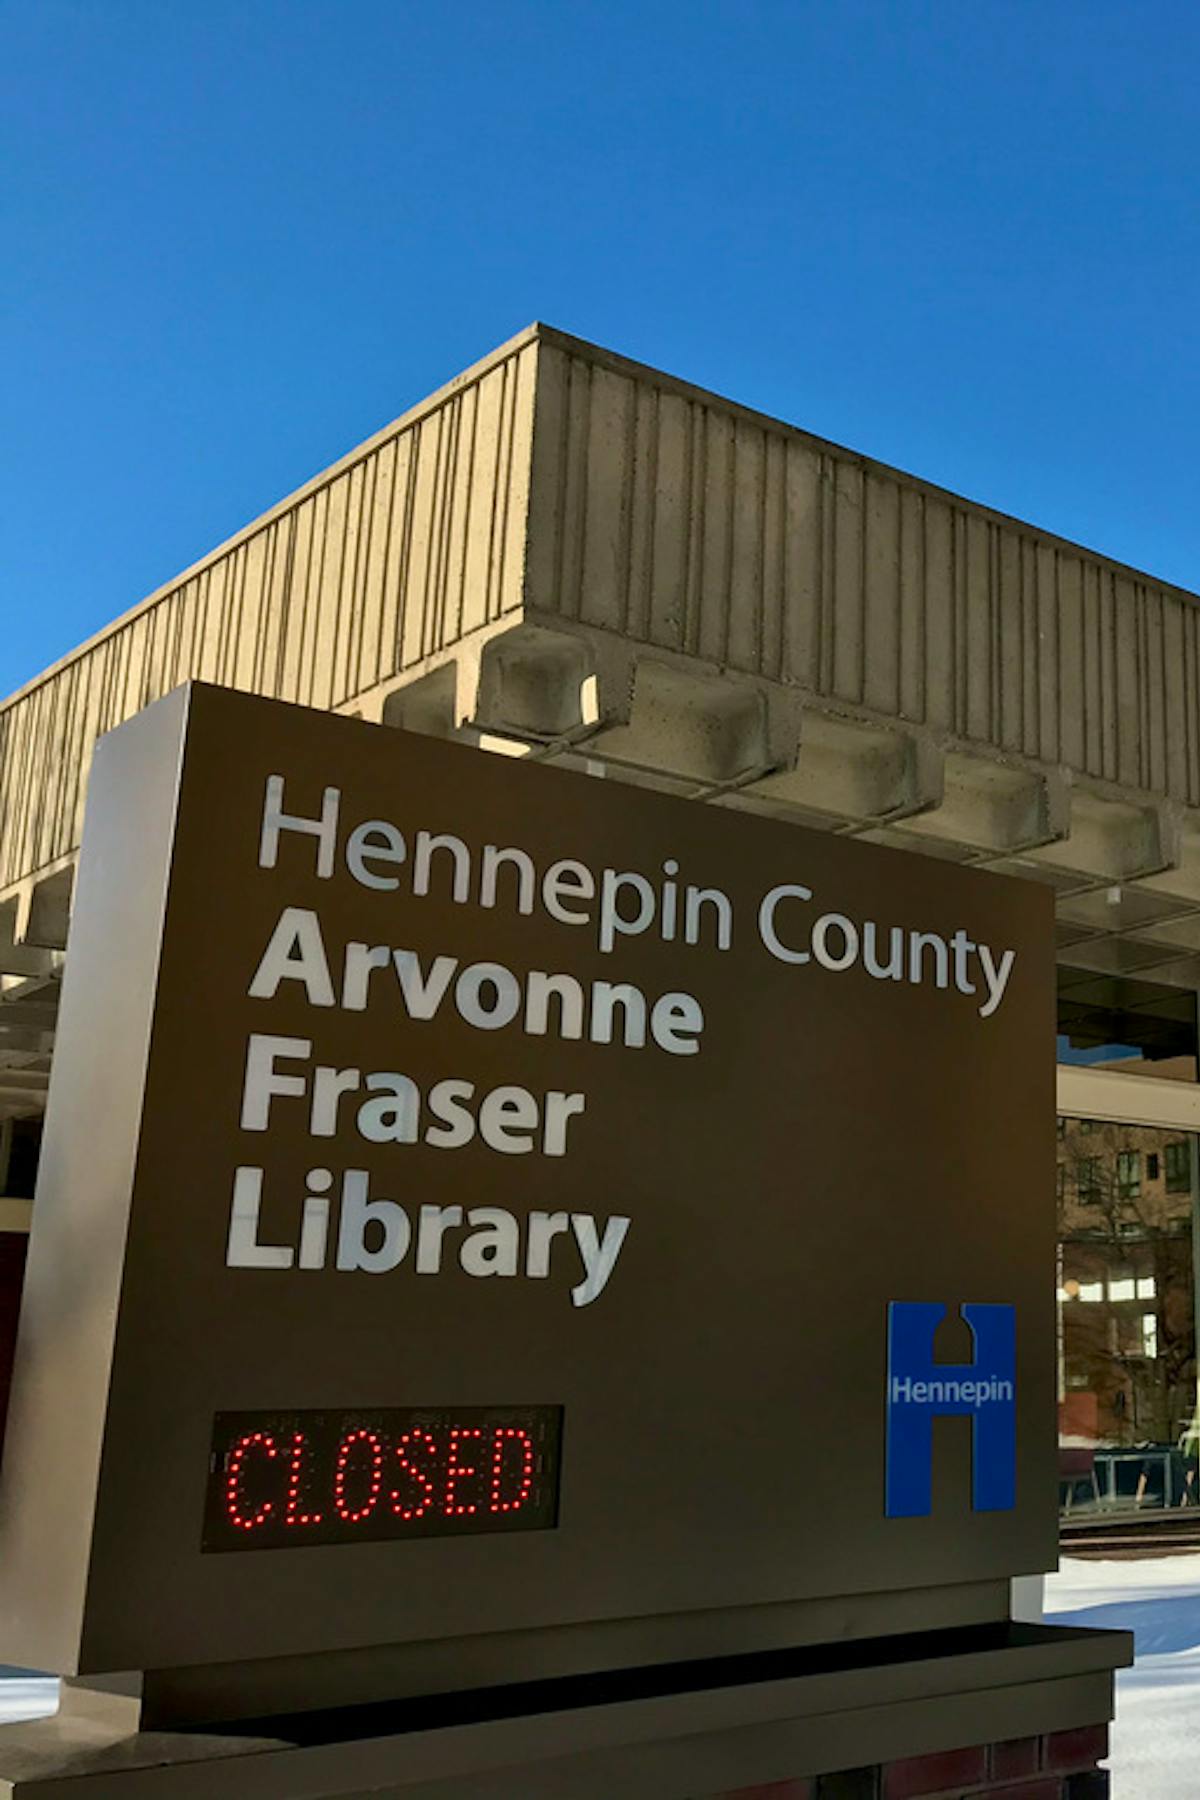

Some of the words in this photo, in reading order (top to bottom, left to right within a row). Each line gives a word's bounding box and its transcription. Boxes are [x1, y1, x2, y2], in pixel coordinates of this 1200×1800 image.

[258, 775, 733, 953] Hennepin
[759, 885, 1016, 1018] County
[248, 906, 705, 1054] Arvonne
[240, 1034, 585, 1157] Fraser
[226, 1165, 630, 1307] Library
[892, 1374, 1013, 1408] Hennepin
[226, 1427, 533, 1528] CLOSED
